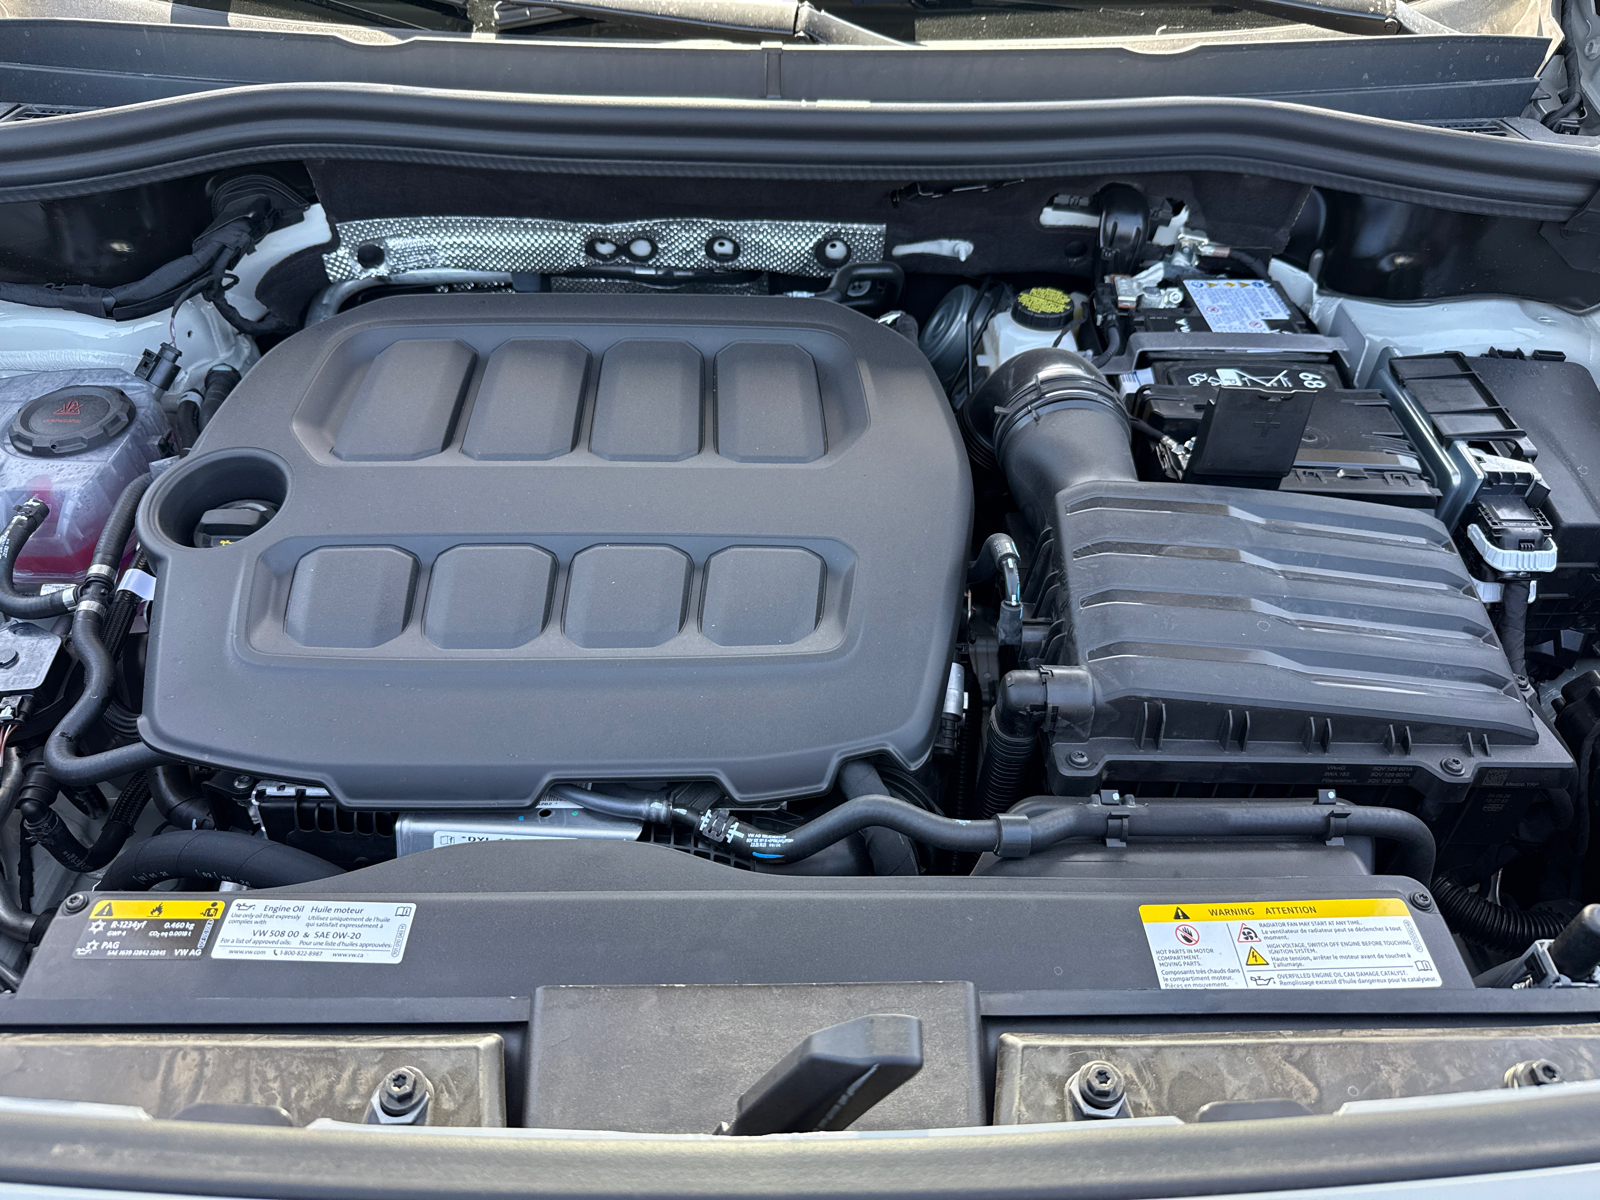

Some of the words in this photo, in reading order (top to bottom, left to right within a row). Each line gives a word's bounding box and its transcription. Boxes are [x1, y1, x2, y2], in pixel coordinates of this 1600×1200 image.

[1298, 372, 1327, 389] 68
[264, 905, 291, 913] Engine
[1208, 908, 1255, 916] WARNING
[1265, 906, 1317, 915] ATTENTION
[110, 920, 147, 930] R-1234yf
[186, 922, 195, 930] kg
[253, 929, 268, 937] VW
[287, 930, 300, 938] 00
[314, 931, 331, 939] SAE
[332, 932, 362, 940] 0W-20
[101, 941, 120, 949] PAG
